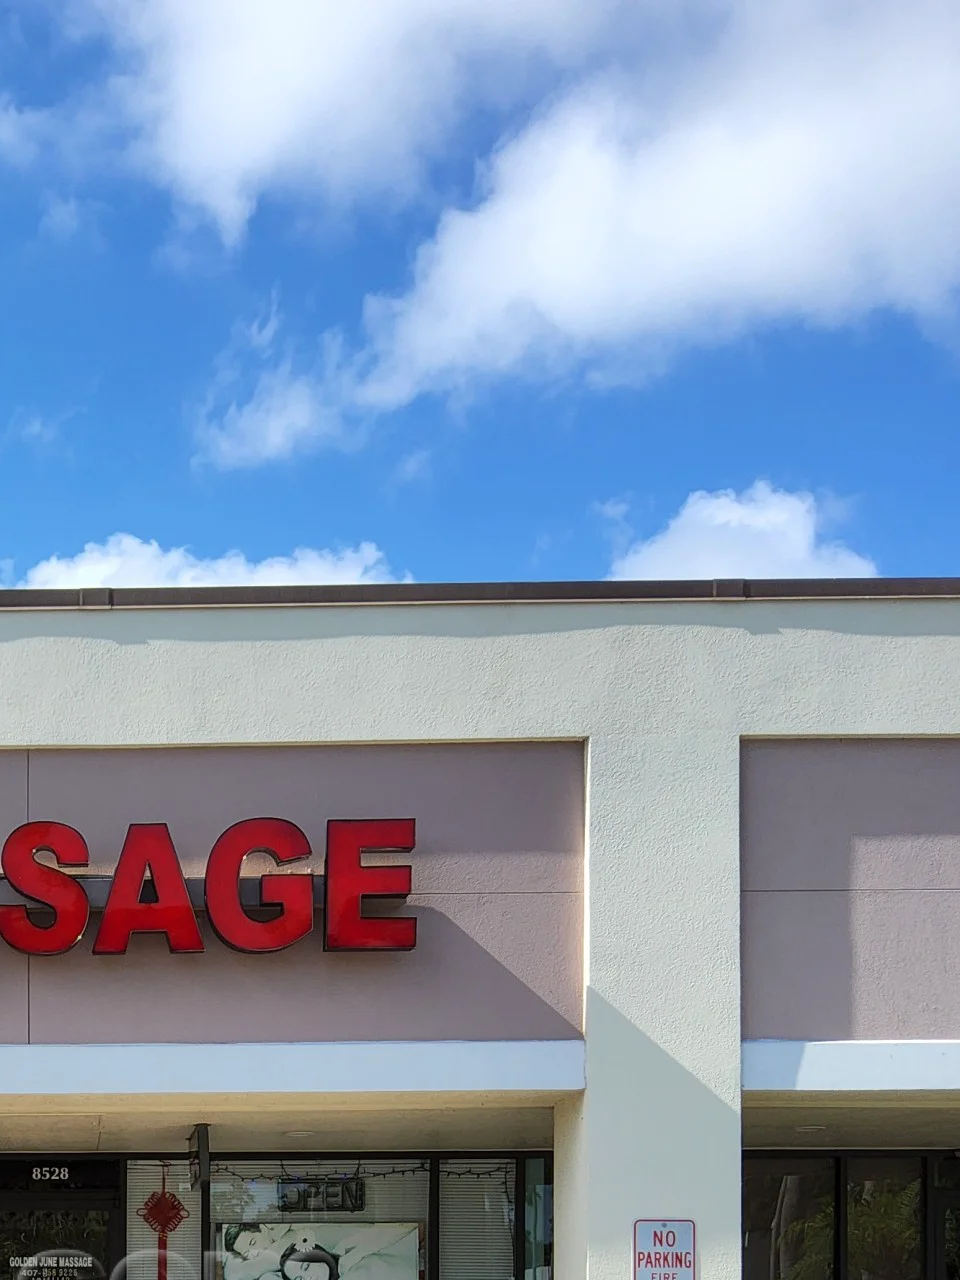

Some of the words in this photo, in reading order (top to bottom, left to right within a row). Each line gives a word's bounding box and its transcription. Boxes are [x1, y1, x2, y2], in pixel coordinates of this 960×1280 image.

[32, 1167, 69, 1180] 8528
[281, 1181, 364, 1210] OPEN
[653, 1230, 676, 1247] NO
[9, 1256, 38, 1267] GOLDEN
[39, 1256, 58, 1267] JUNE
[59, 1256, 93, 1267] MASSAGE
[637, 1251, 692, 1268] PARKING
